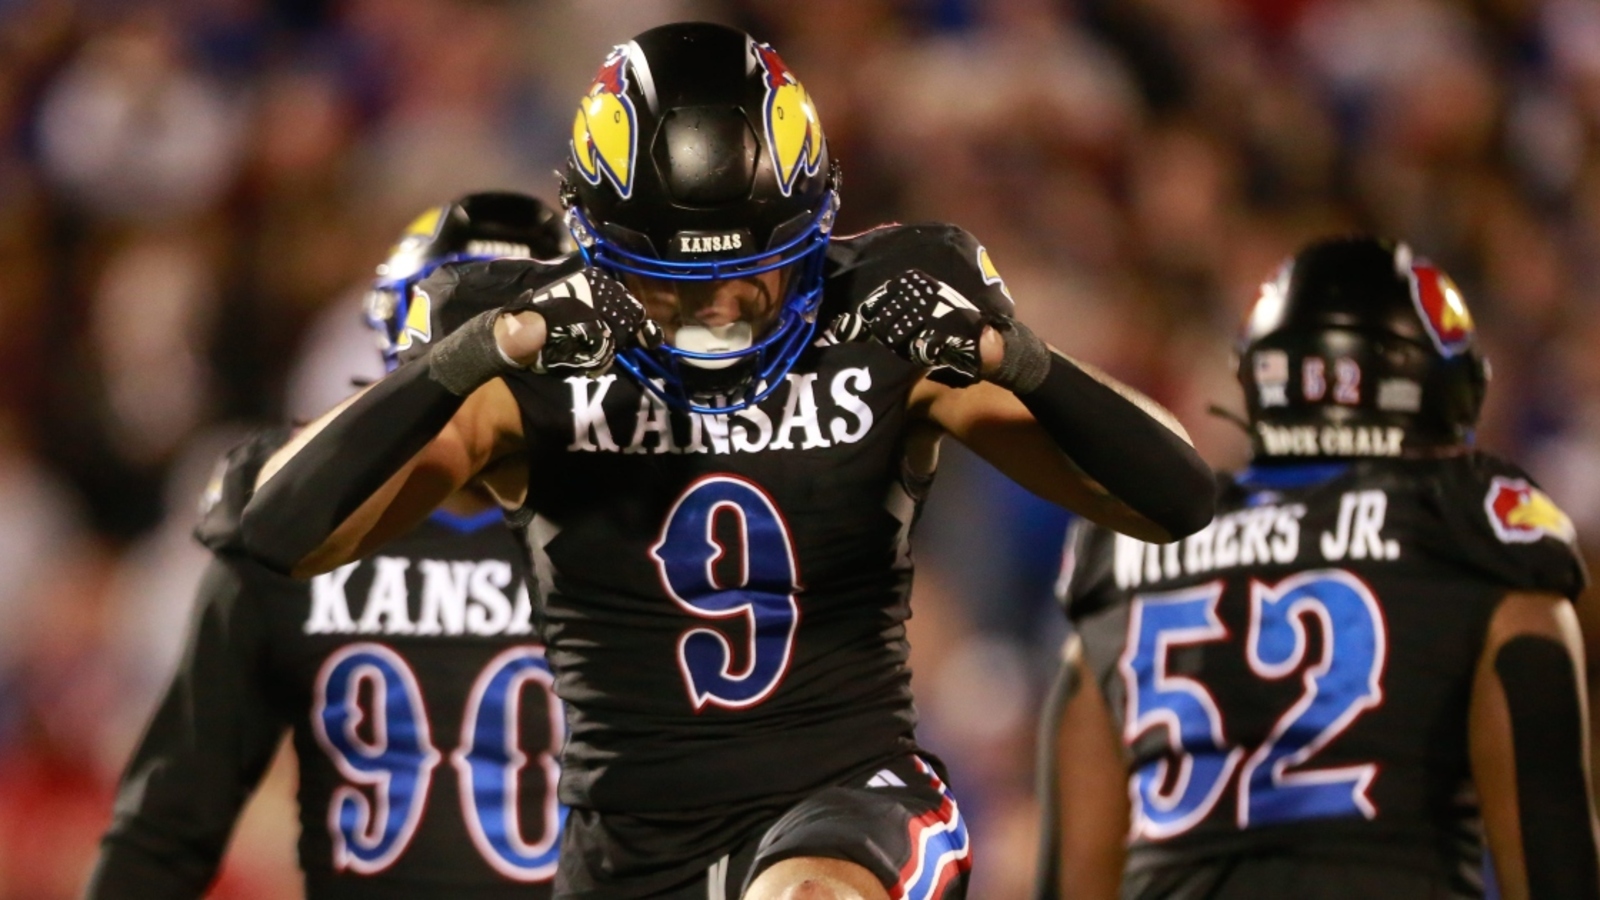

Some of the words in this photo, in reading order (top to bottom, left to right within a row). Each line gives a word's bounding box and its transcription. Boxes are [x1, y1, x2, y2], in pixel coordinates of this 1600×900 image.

[680, 233, 742, 253] KANSAS
[563, 366, 874, 455] KANSAS
[648, 472, 805, 714] 9
[1320, 489, 1400, 561] JR.
[312, 642, 571, 883] 90
[1119, 568, 1388, 842] 52
